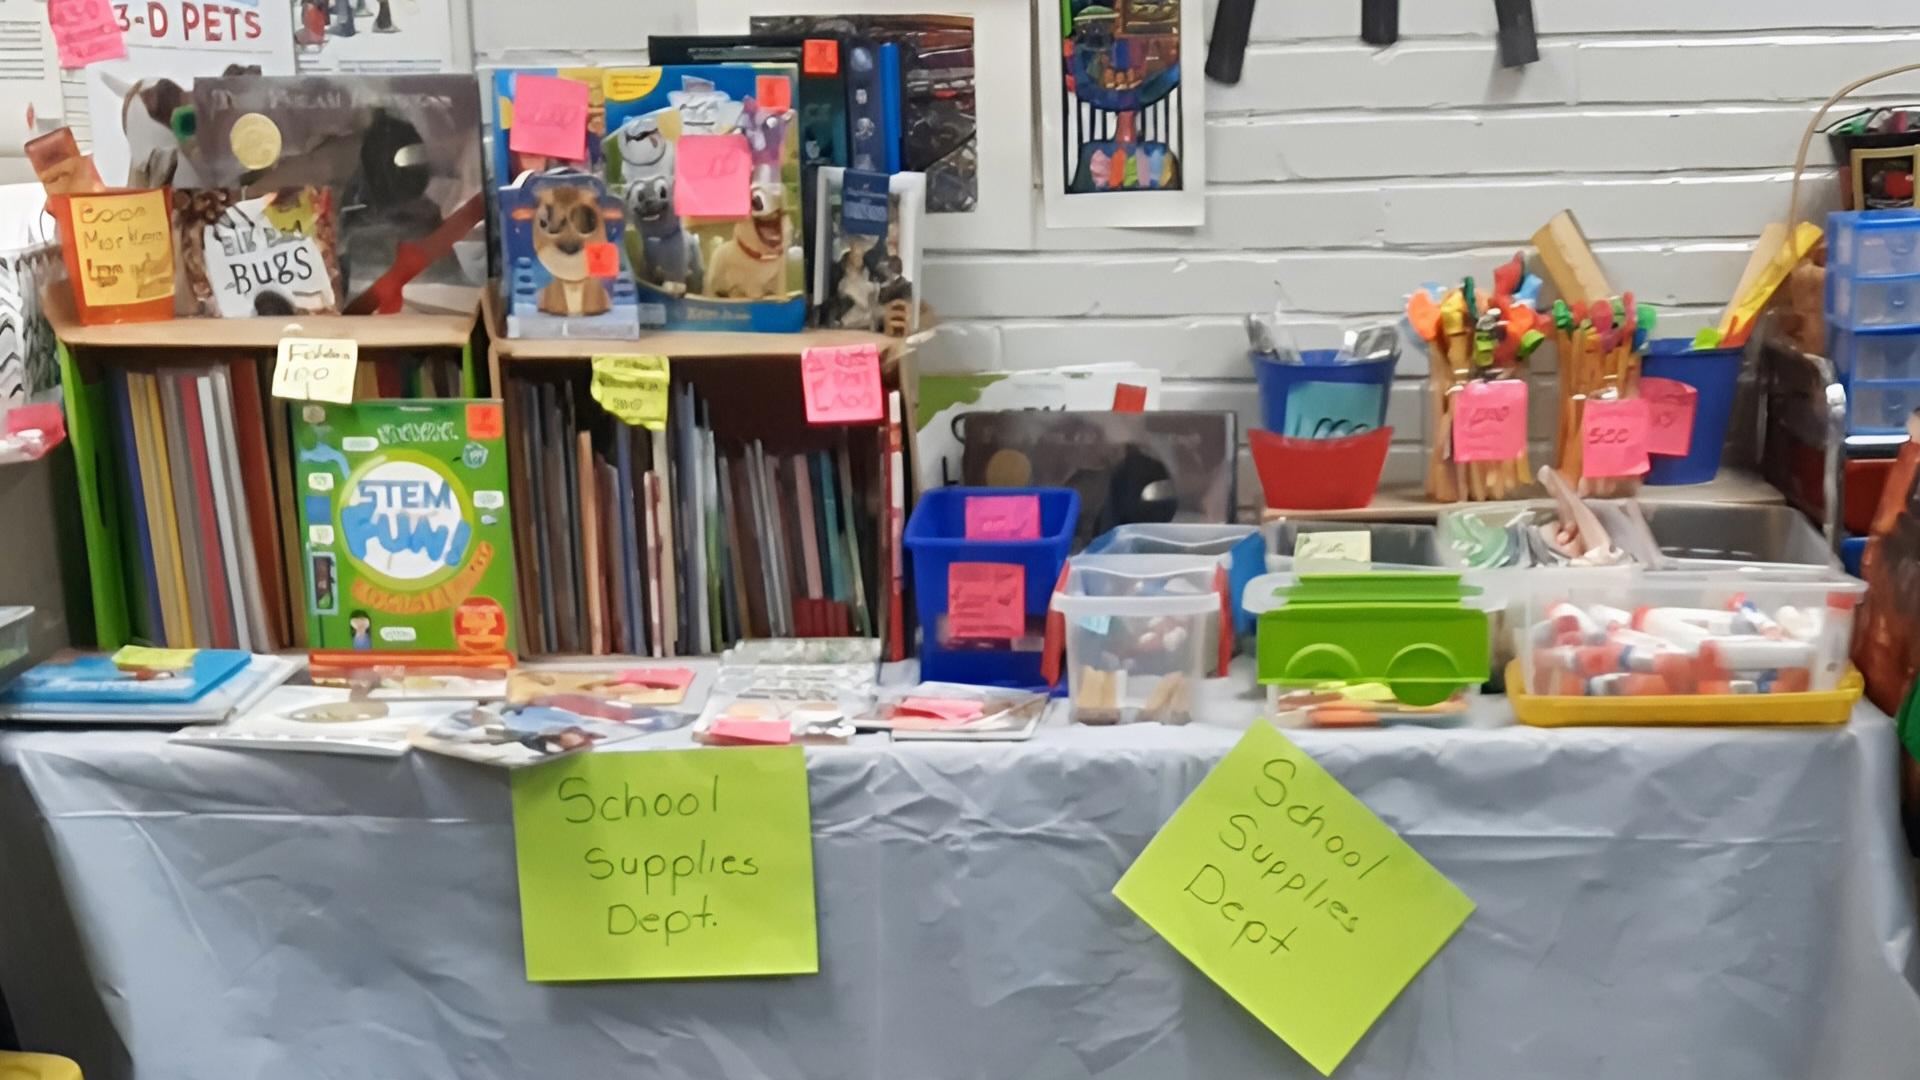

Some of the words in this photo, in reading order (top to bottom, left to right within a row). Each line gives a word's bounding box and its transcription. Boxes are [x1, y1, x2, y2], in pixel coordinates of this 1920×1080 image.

[113, 2, 169, 38] 3-D
[182, 2, 262, 41] PETS
[358, 480, 452, 509] STEM
[558, 774, 719, 824] School
[1255, 758, 1390, 880] School
[584, 839, 759, 896] Supplies
[1219, 814, 1360, 933] Supplies
[608, 895, 719, 947] Dept.
[1184, 864, 1298, 955] Dept
